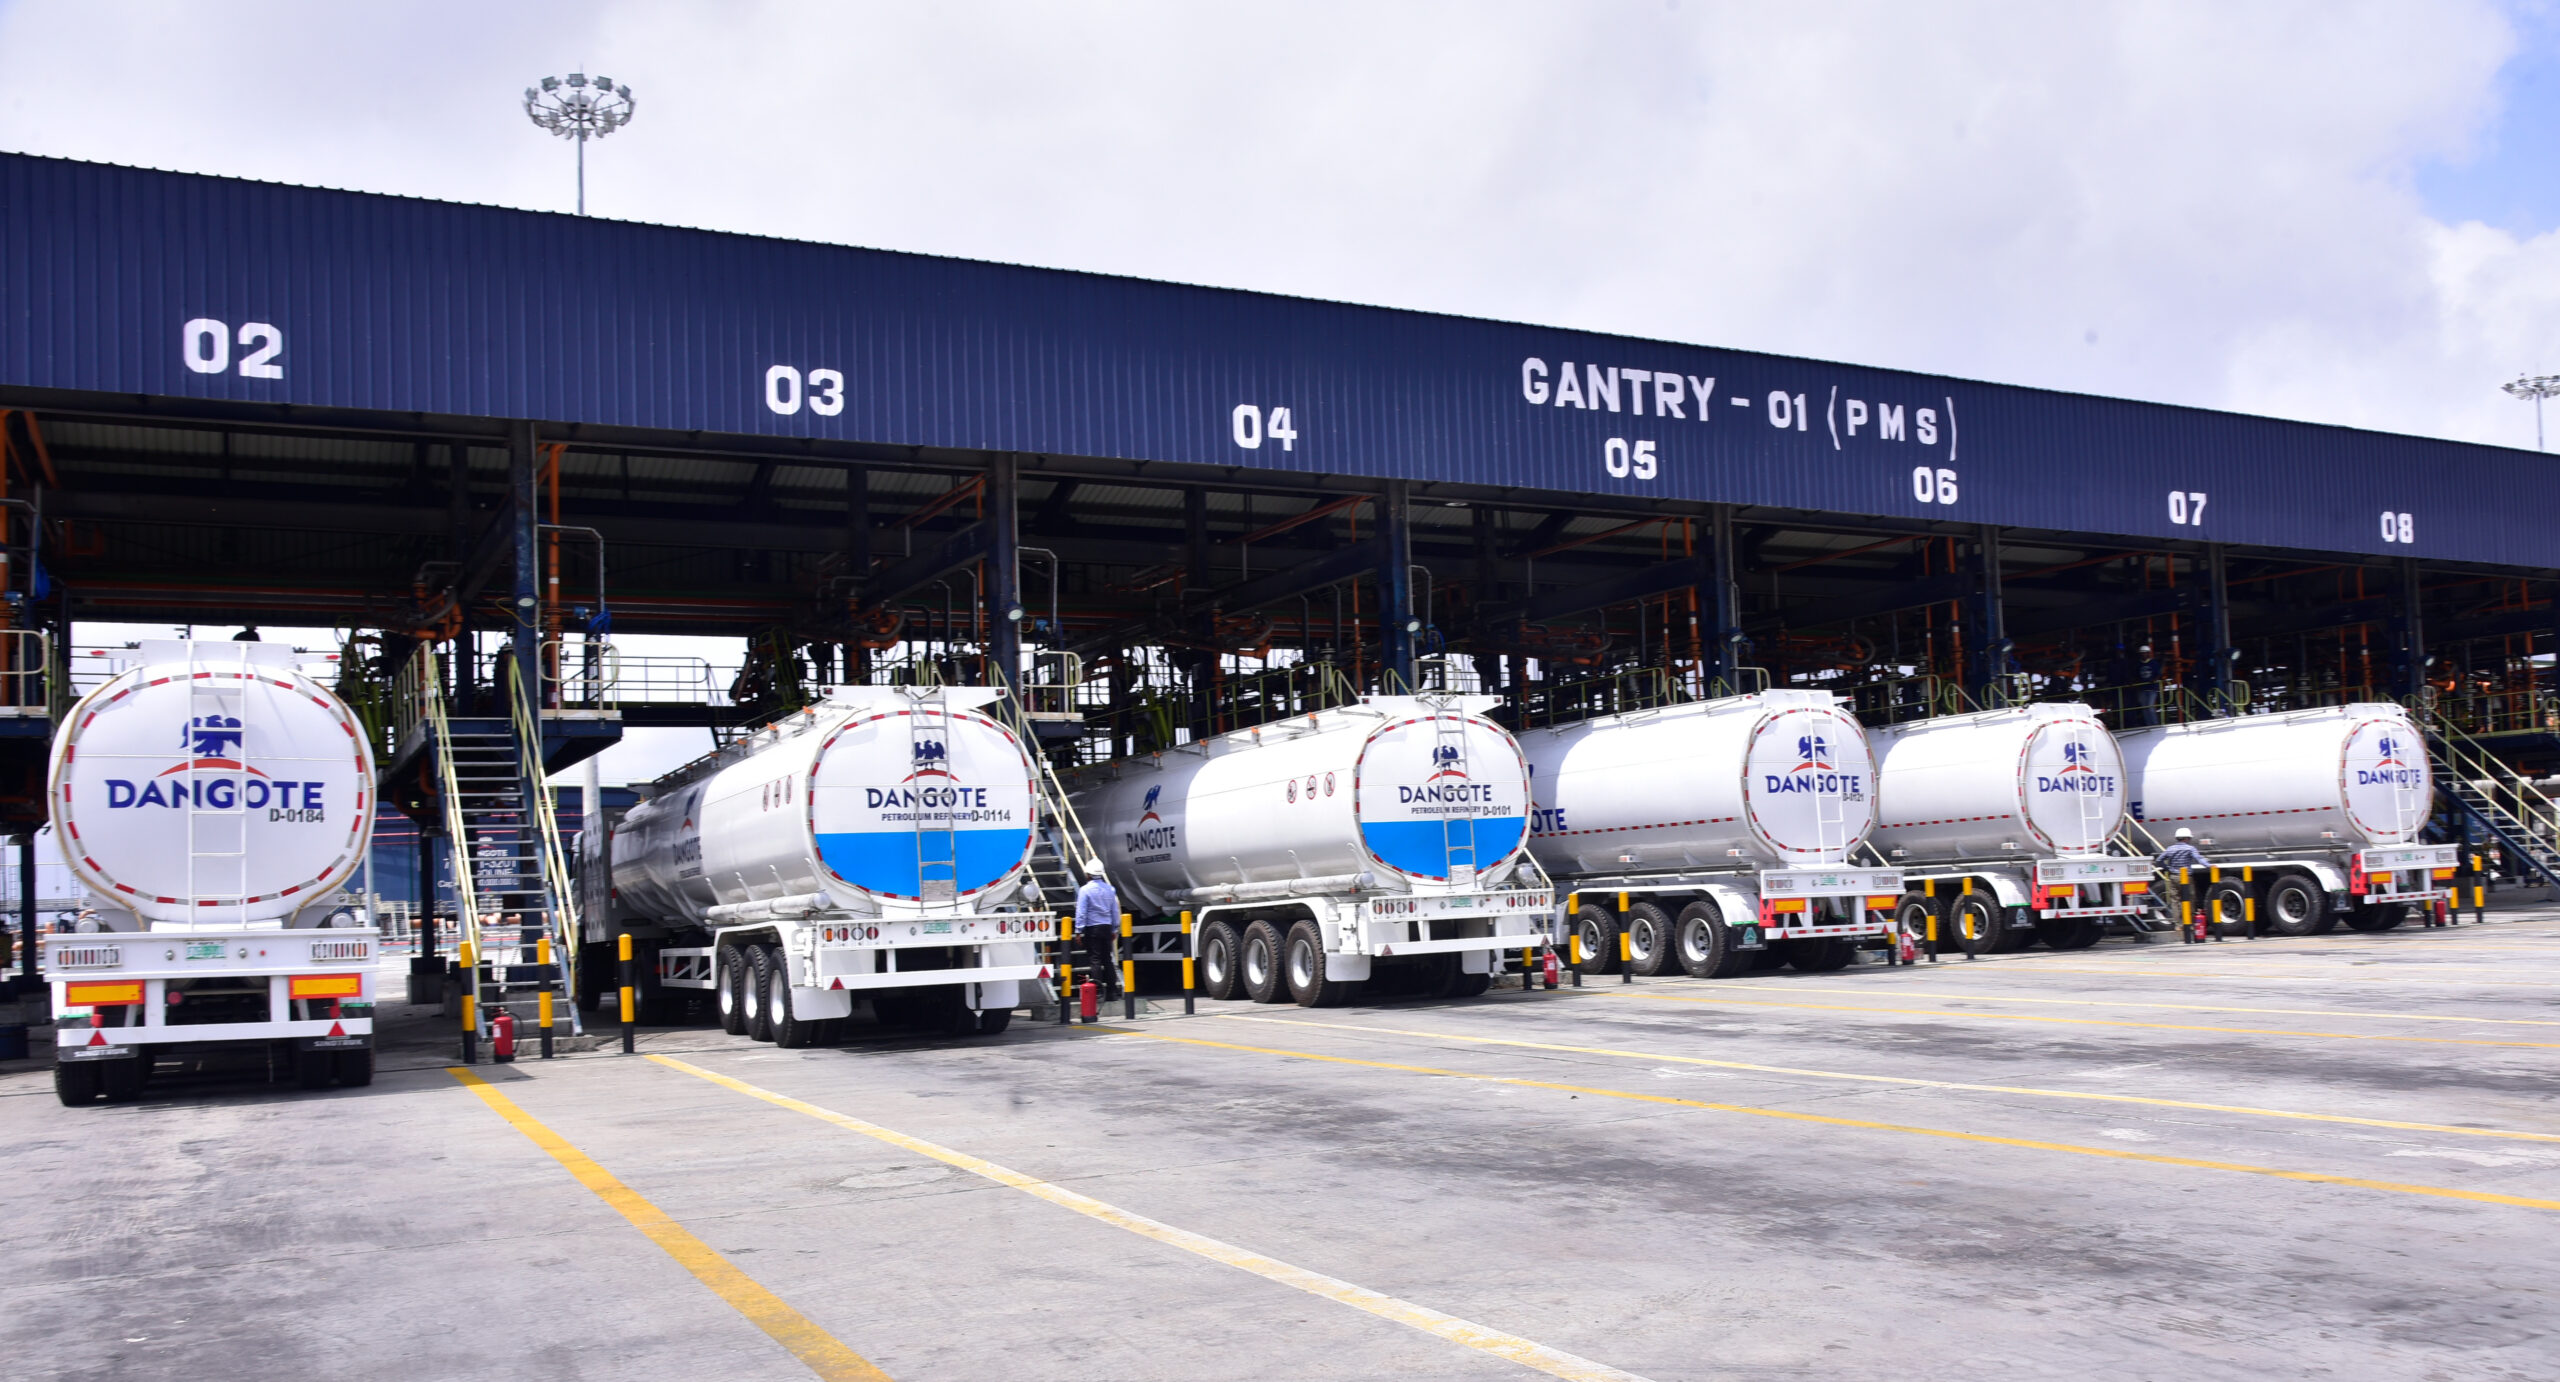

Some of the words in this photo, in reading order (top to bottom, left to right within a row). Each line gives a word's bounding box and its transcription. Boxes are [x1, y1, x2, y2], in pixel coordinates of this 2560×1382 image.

[184, 318, 284, 380] 02
[765, 364, 845, 418] 03
[1522, 357, 1716, 422] GANTRY
[1767, 390, 1808, 432] 01
[1232, 403, 1299, 452] 04
[1604, 437, 1658, 480] 05
[1912, 466, 1959, 505] 06
[2168, 490, 2208, 526] 07
[2380, 511, 2415, 544] 08
[1764, 774, 1860, 794] DANGOTE
[2037, 776, 2115, 792] DANGOTE
[2356, 768, 2421, 785] DANGOTE
[104, 778, 325, 809] DANGOTE
[865, 787, 988, 809] DANGOTE
[1398, 784, 1492, 803] DANGOTE
[269, 807, 325, 823] D-0184
[881, 812, 932, 822] PETROLEUM
[933, 812, 972, 821] REFNERY
[971, 809, 1011, 822] D-0114
[1482, 805, 1512, 816] D-0101
[1126, 826, 1176, 853] DANGOTE
